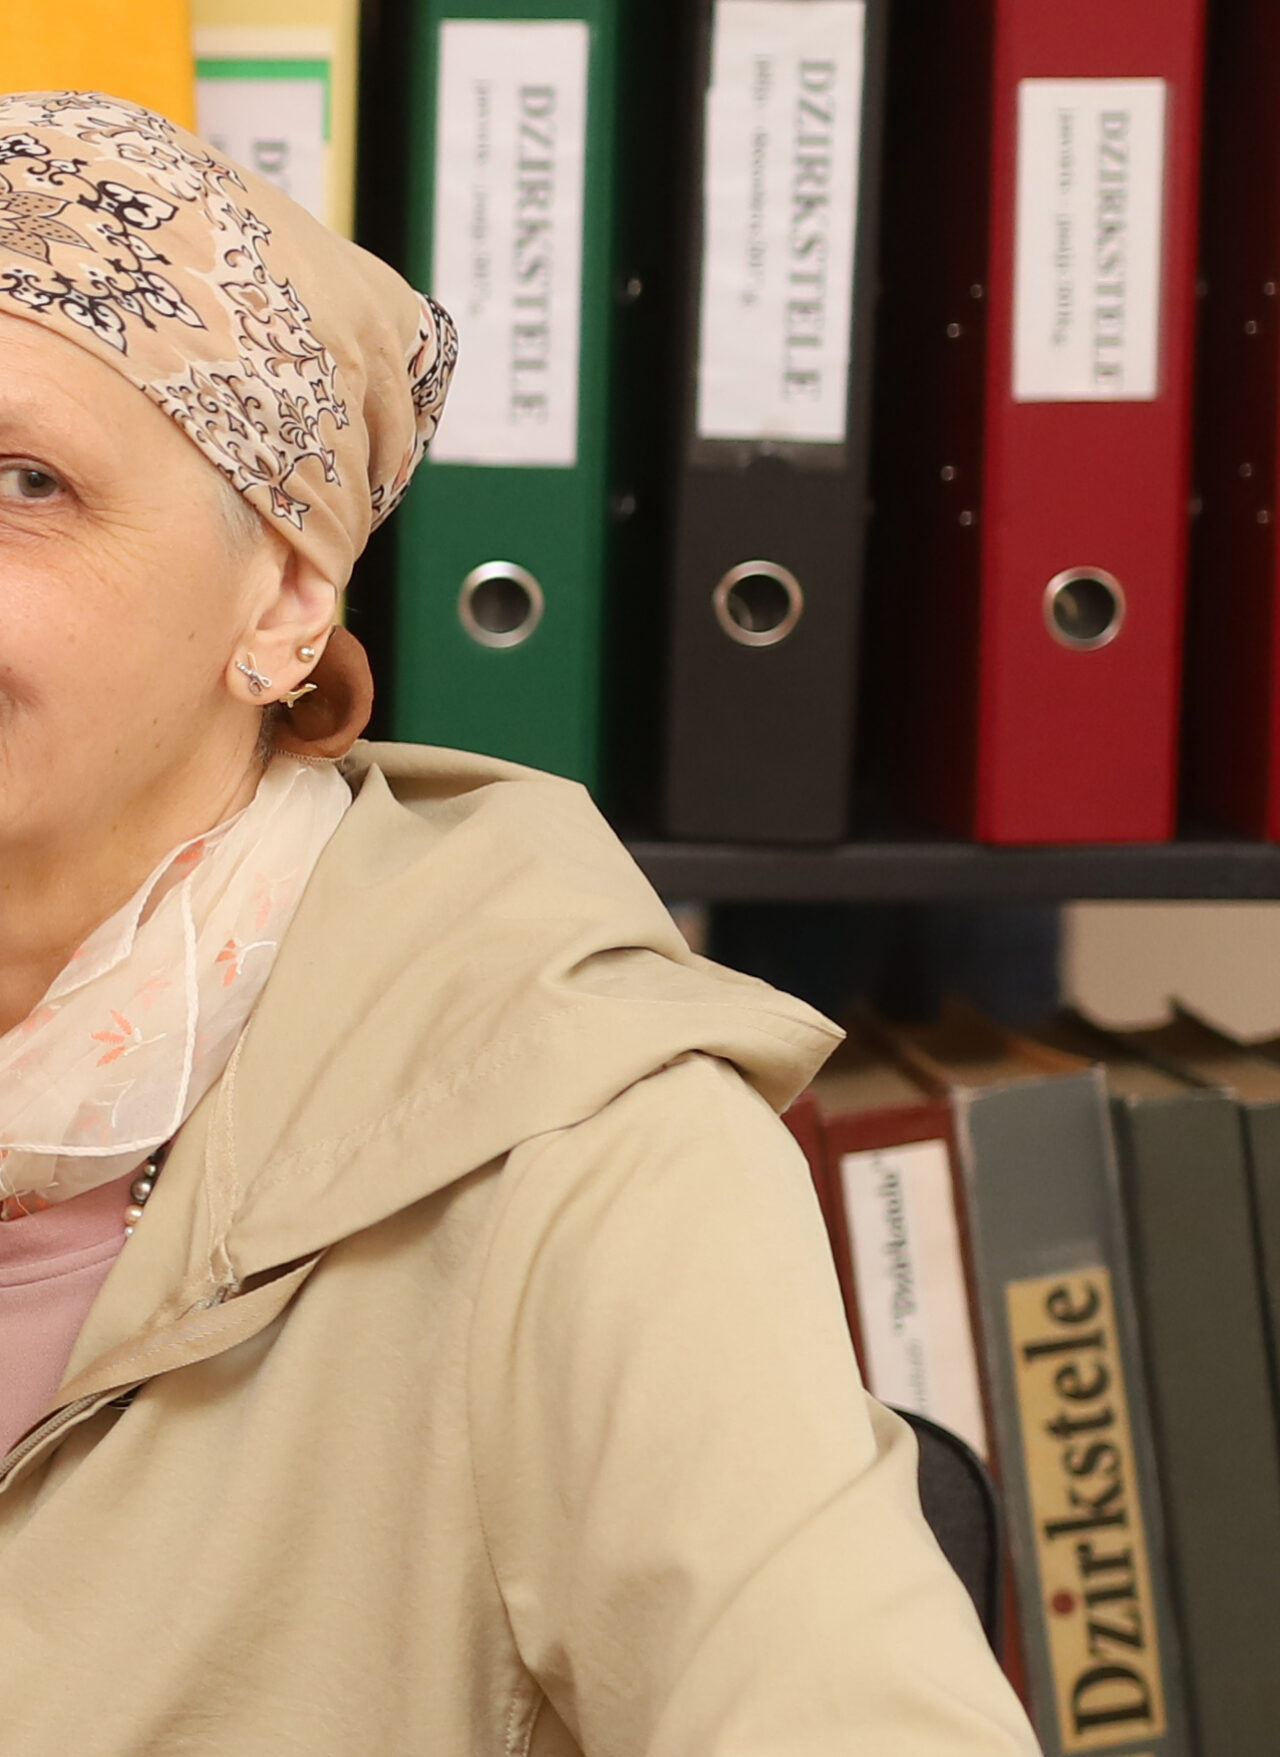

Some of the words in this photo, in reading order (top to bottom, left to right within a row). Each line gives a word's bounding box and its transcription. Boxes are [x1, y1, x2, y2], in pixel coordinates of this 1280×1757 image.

[509, 83, 556, 424] DZIRKSTELE
[783, 57, 836, 402] DZIRKSTELE
[1093, 109, 1129, 387] DZIRKSTELE
[1025, 1278, 1151, 1739] Dzirkstele
